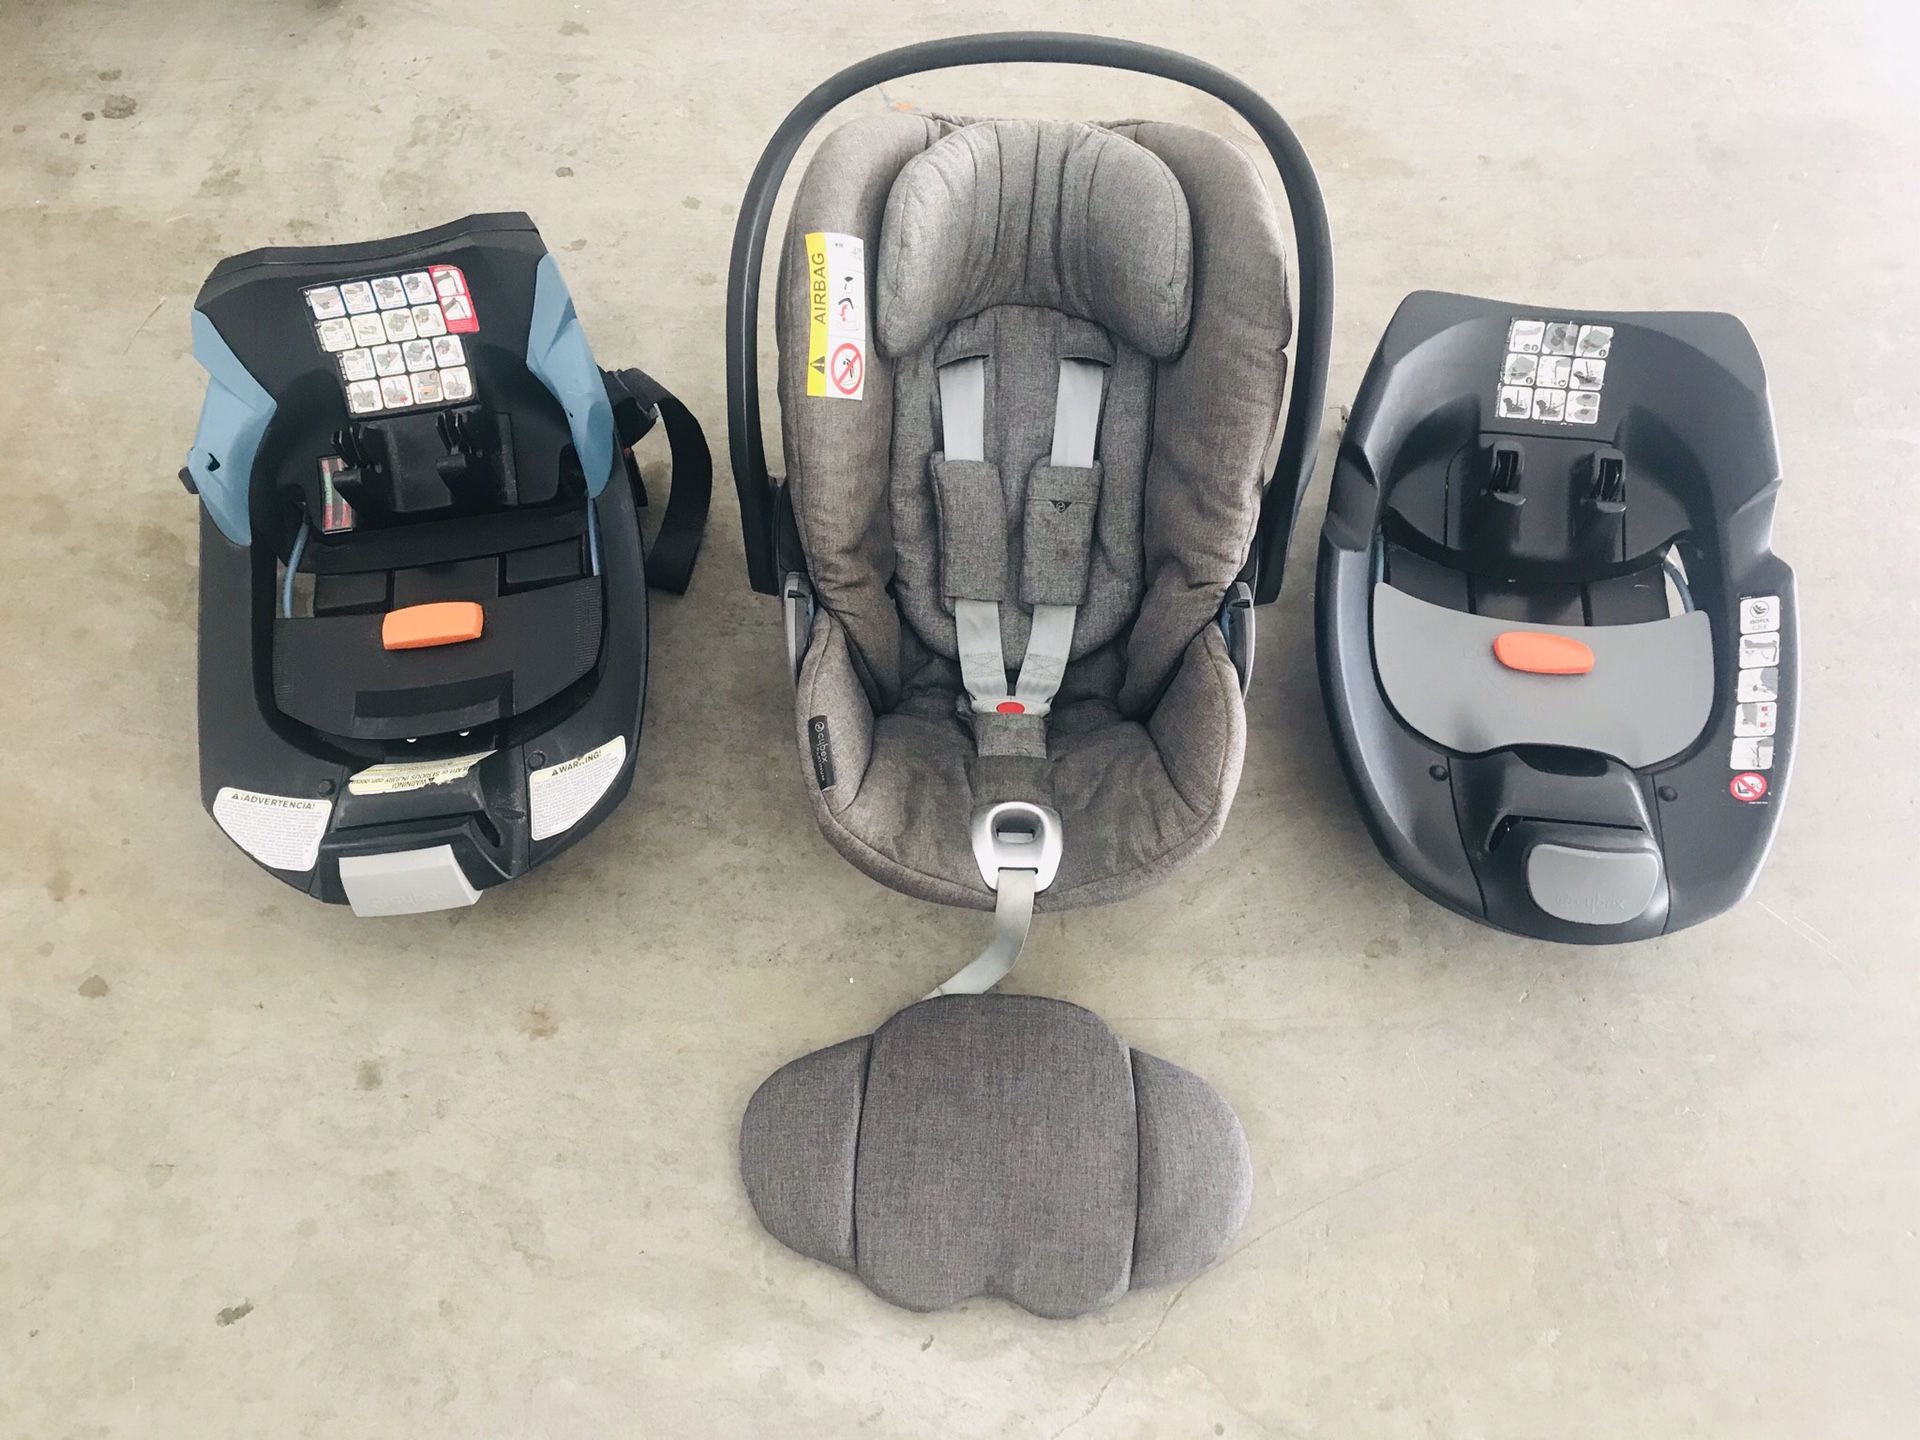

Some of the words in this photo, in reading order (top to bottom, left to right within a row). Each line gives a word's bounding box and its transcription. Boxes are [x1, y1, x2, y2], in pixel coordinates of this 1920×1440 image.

[811, 252, 827, 325] AIRBAG
[817, 732, 829, 764] cybex
[239, 794, 316, 811] ¡ADVERTENCIA!
